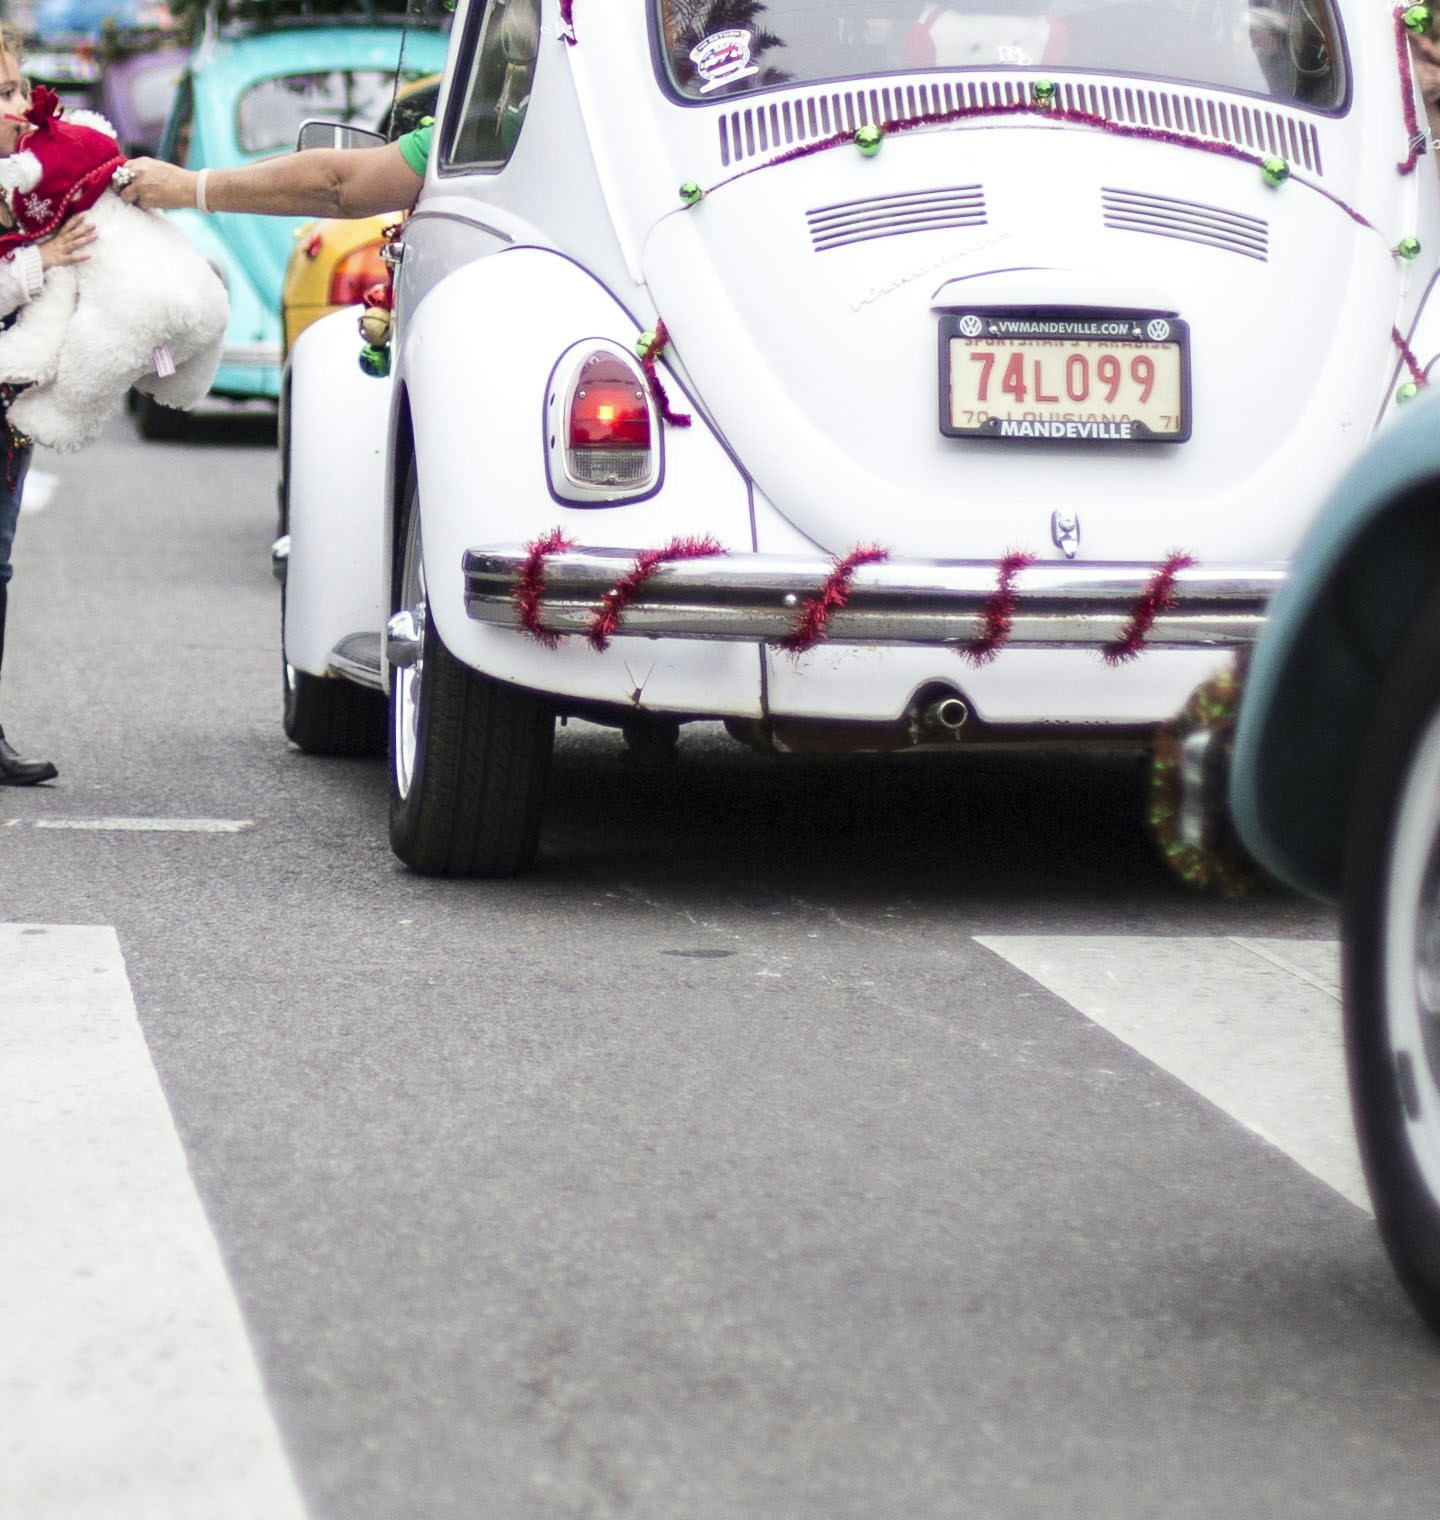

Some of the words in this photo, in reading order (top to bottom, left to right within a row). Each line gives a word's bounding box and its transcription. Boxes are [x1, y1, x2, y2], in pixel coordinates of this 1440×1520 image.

[999, 320, 1129, 334] VWMANDEVILLE.COM
[970, 353, 1155, 403] 74L099
[1000, 420, 1131, 439] MANDEVILLE
